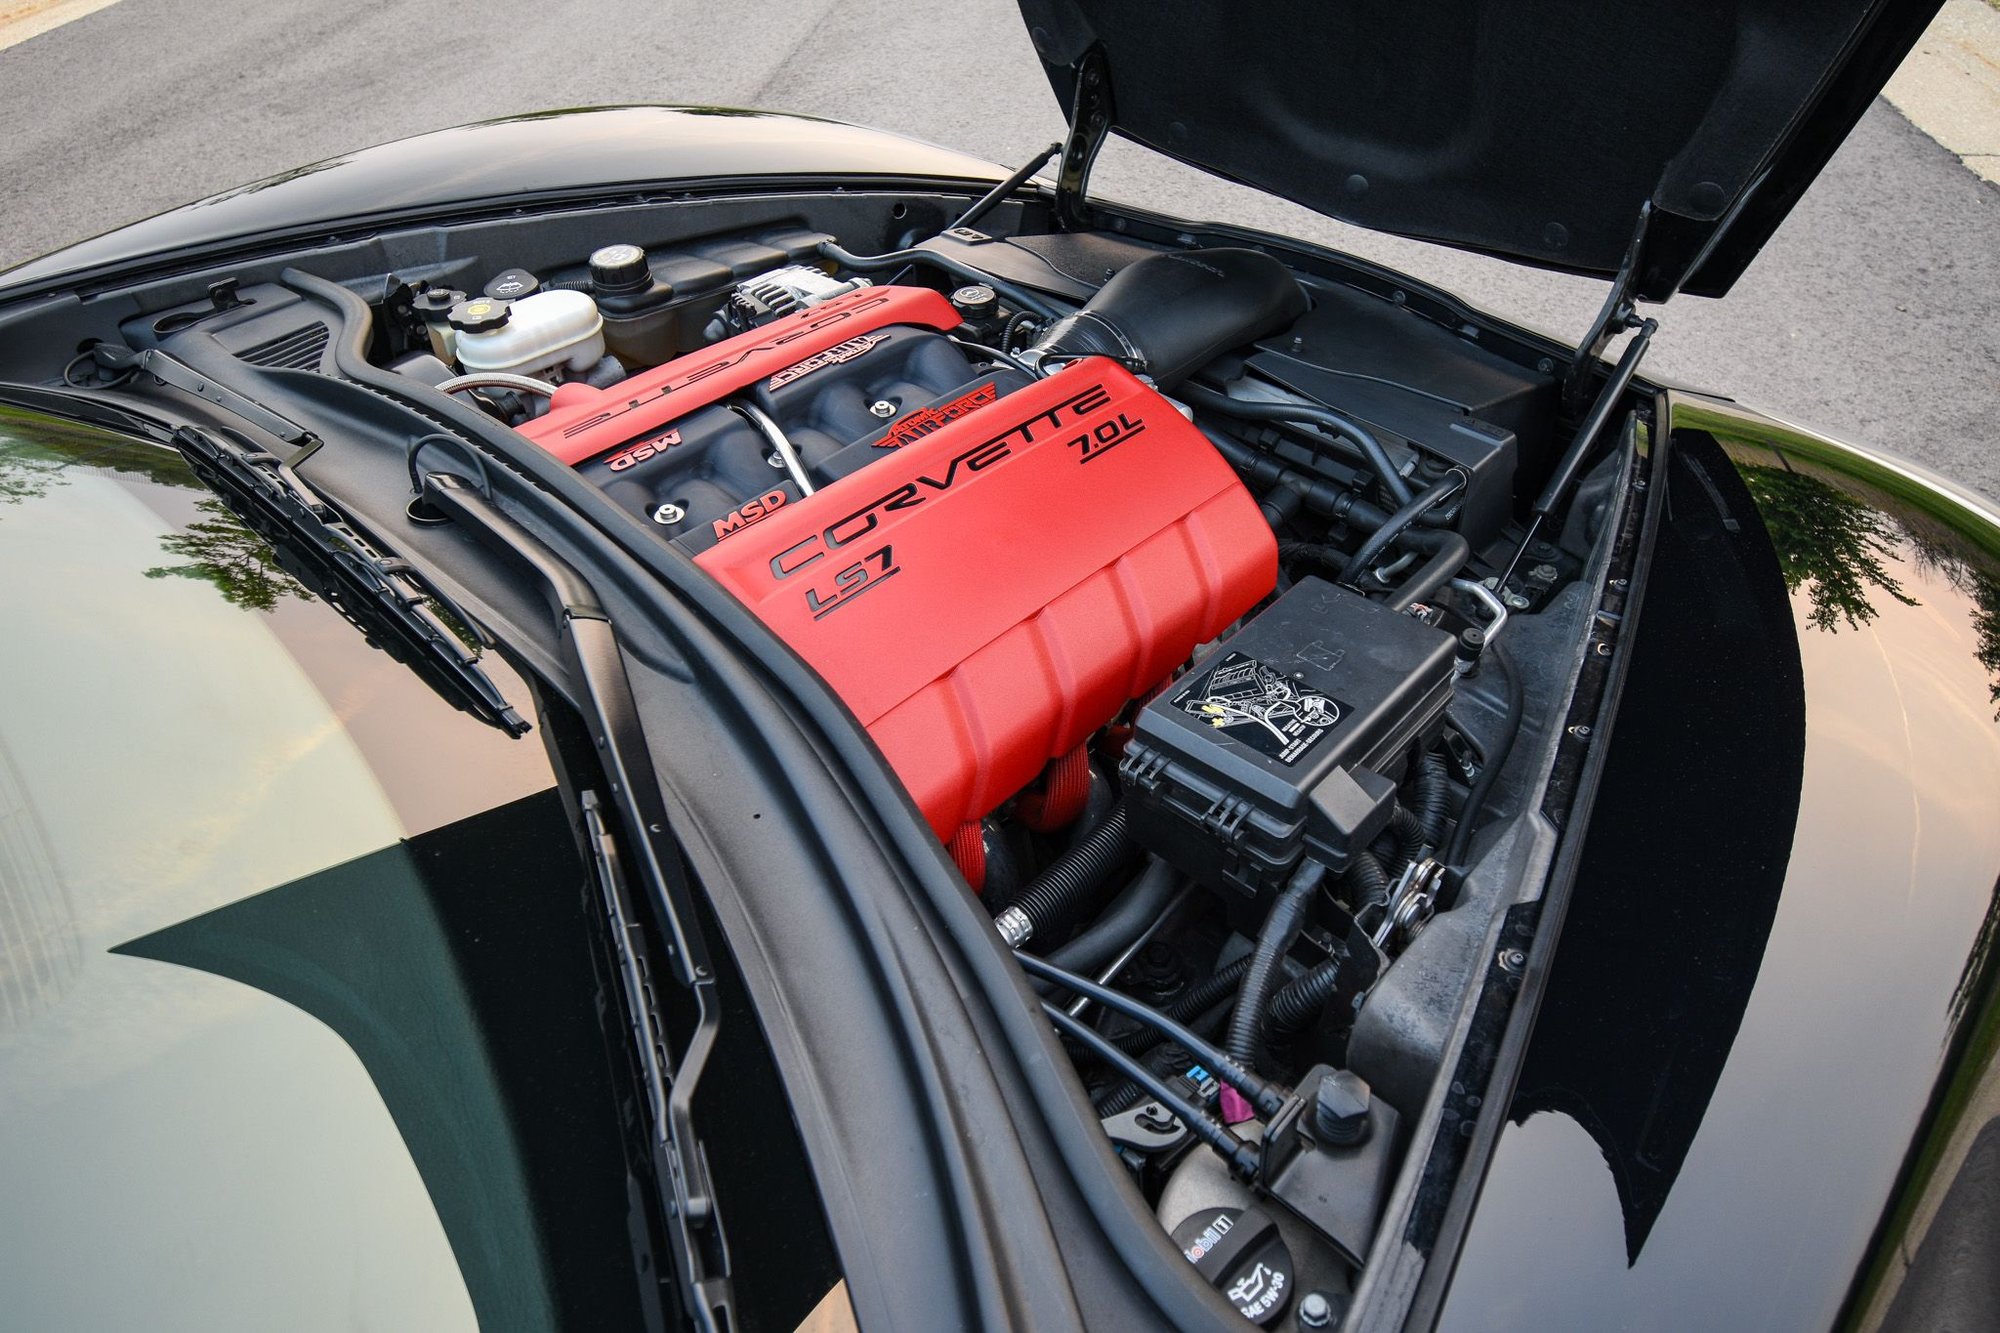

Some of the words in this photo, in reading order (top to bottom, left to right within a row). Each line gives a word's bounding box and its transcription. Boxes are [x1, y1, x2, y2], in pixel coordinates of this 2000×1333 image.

[563, 297, 889, 439] CORVETTE
[609, 433, 683, 472] MSD
[1066, 412, 1144, 456] 7.0L
[768, 383, 1113, 581] CORVETTE
[712, 489, 787, 538] MSD
[804, 544, 894, 613] LS7
[1260, 1272, 1285, 1308] 5W-30
